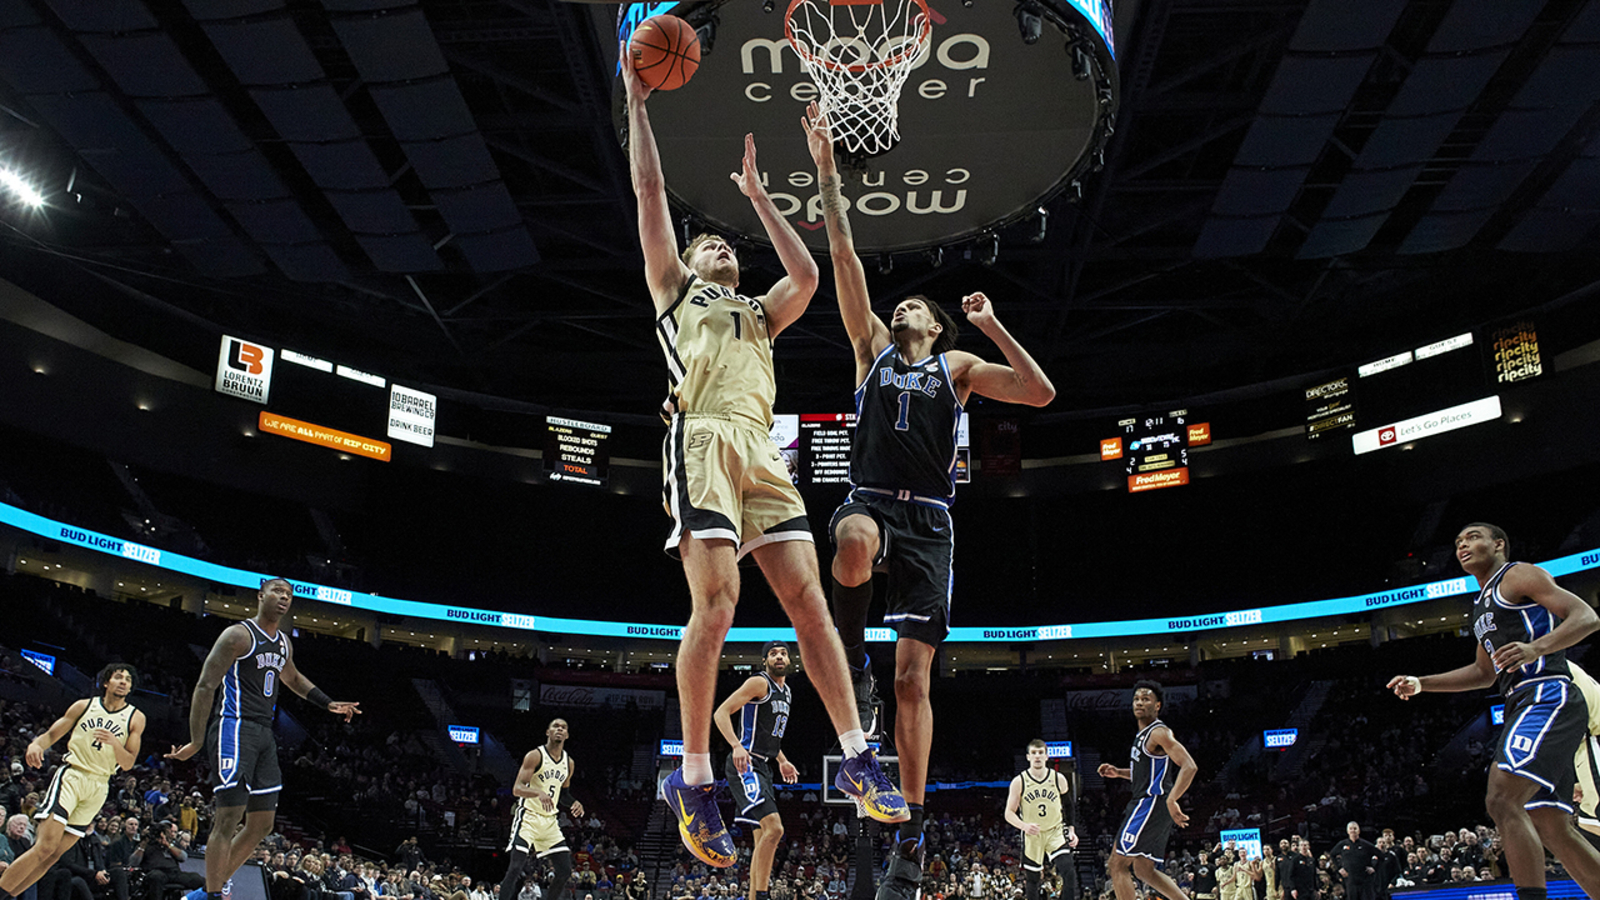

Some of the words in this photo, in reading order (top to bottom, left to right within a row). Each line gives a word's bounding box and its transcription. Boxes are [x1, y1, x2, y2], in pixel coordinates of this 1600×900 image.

[741, 25, 990, 73] moda
[730, 311, 740, 340] 1
[223, 379, 263, 396] BRUUN
[224, 370, 263, 388] LORENTZ
[880, 367, 941, 398] DUKE
[895, 391, 910, 431] 1
[390, 418, 412, 431] DRINK
[413, 425, 433, 436] BEER
[1400, 423, 1421, 436] Let's
[1424, 419, 1439, 429] Go
[1440, 410, 1472, 425] Places
[264, 418, 279, 429] WE
[280, 422, 296, 433] ARE
[297, 427, 313, 437] ALL
[315, 431, 333, 441] PART
[343, 438, 362, 448] RIP
[362, 443, 386, 454] CITY
[560, 444, 595, 455] REBOUNDS
[561, 454, 592, 464] STEALS
[563, 464, 588, 475] TOTAL
[61, 527, 87, 542] BUD
[88, 535, 123, 552] LIGHT
[122, 542, 161, 565] SELTZER
[1581, 553, 1600, 566] BU
[290, 583, 318, 596] IGHT
[317, 586, 351, 605] SELTZER
[1365, 595, 1390, 607] BUD
[1391, 588, 1425, 603] LIGHT
[1426, 578, 1466, 600] SELTZER
[447, 609, 470, 619] BUD
[470, 611, 501, 623] LIGHT
[501, 613, 534, 629] SELTZER
[1168, 619, 1191, 630] BUD
[1192, 615, 1224, 628] LIGHT
[1225, 609, 1262, 626] SELTZER
[627, 626, 648, 636] BUD
[649, 627, 680, 638] LIGHT
[864, 628, 891, 641] ELTZER
[983, 630, 1004, 640] BUD
[1005, 629, 1037, 640] LIGHT
[1038, 626, 1072, 641] SELTZER
[263, 670, 275, 697] 0
[80, 717, 125, 738] PURDUE
[771, 714, 788, 738] 13
[91, 738, 103, 751] 4
[1267, 734, 1296, 746] SELTZER
[1511, 734, 1533, 752] D
[662, 744, 684, 755] SELTZE
[1046, 746, 1070, 757] ELTZER
[222, 757, 233, 770] D
[538, 769, 566, 782] PURDU
[548, 785, 556, 798] 5
[1024, 789, 1058, 804] PURDUE
[1038, 804, 1046, 817] 3
